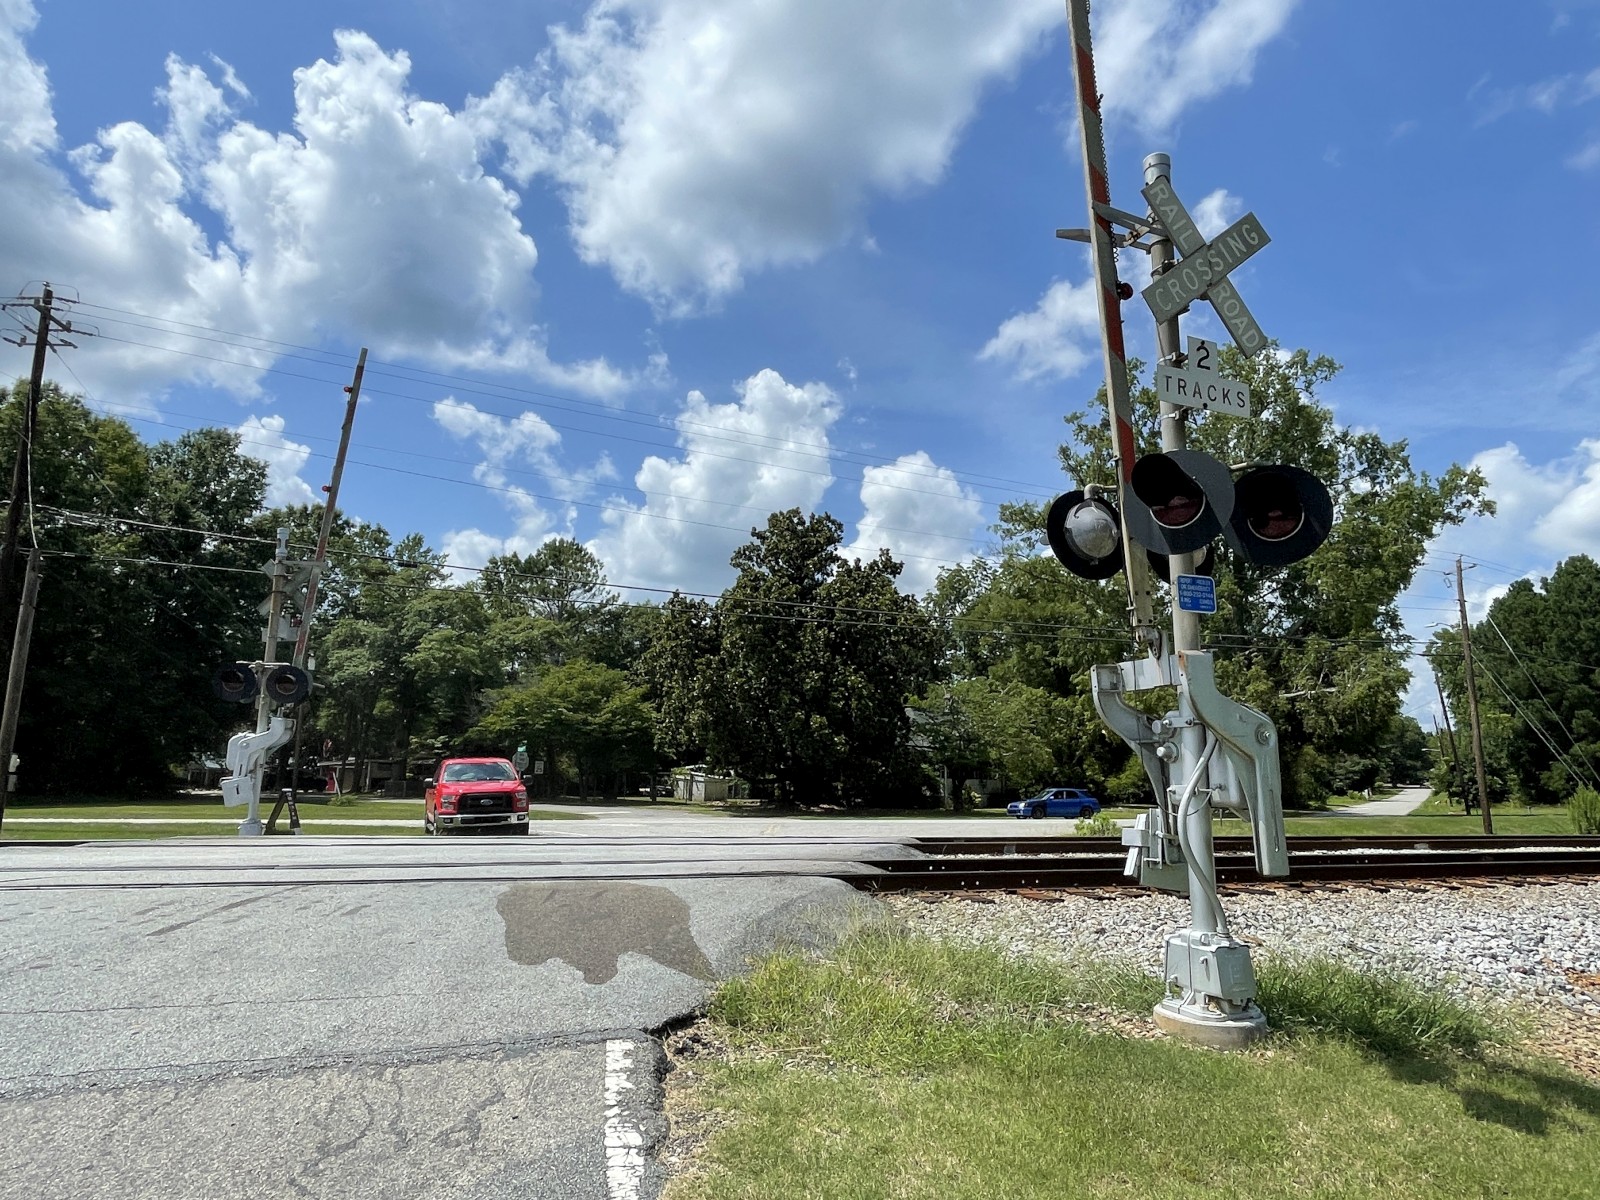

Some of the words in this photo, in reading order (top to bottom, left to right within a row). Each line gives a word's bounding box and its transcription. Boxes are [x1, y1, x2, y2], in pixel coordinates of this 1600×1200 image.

[1150, 183, 1192, 251] RAIL
[1214, 284, 1259, 348] ROAD
[1155, 224, 1259, 311] CROSSING
[1196, 345, 1210, 370] 2
[1164, 375, 1245, 408] TRACKS
